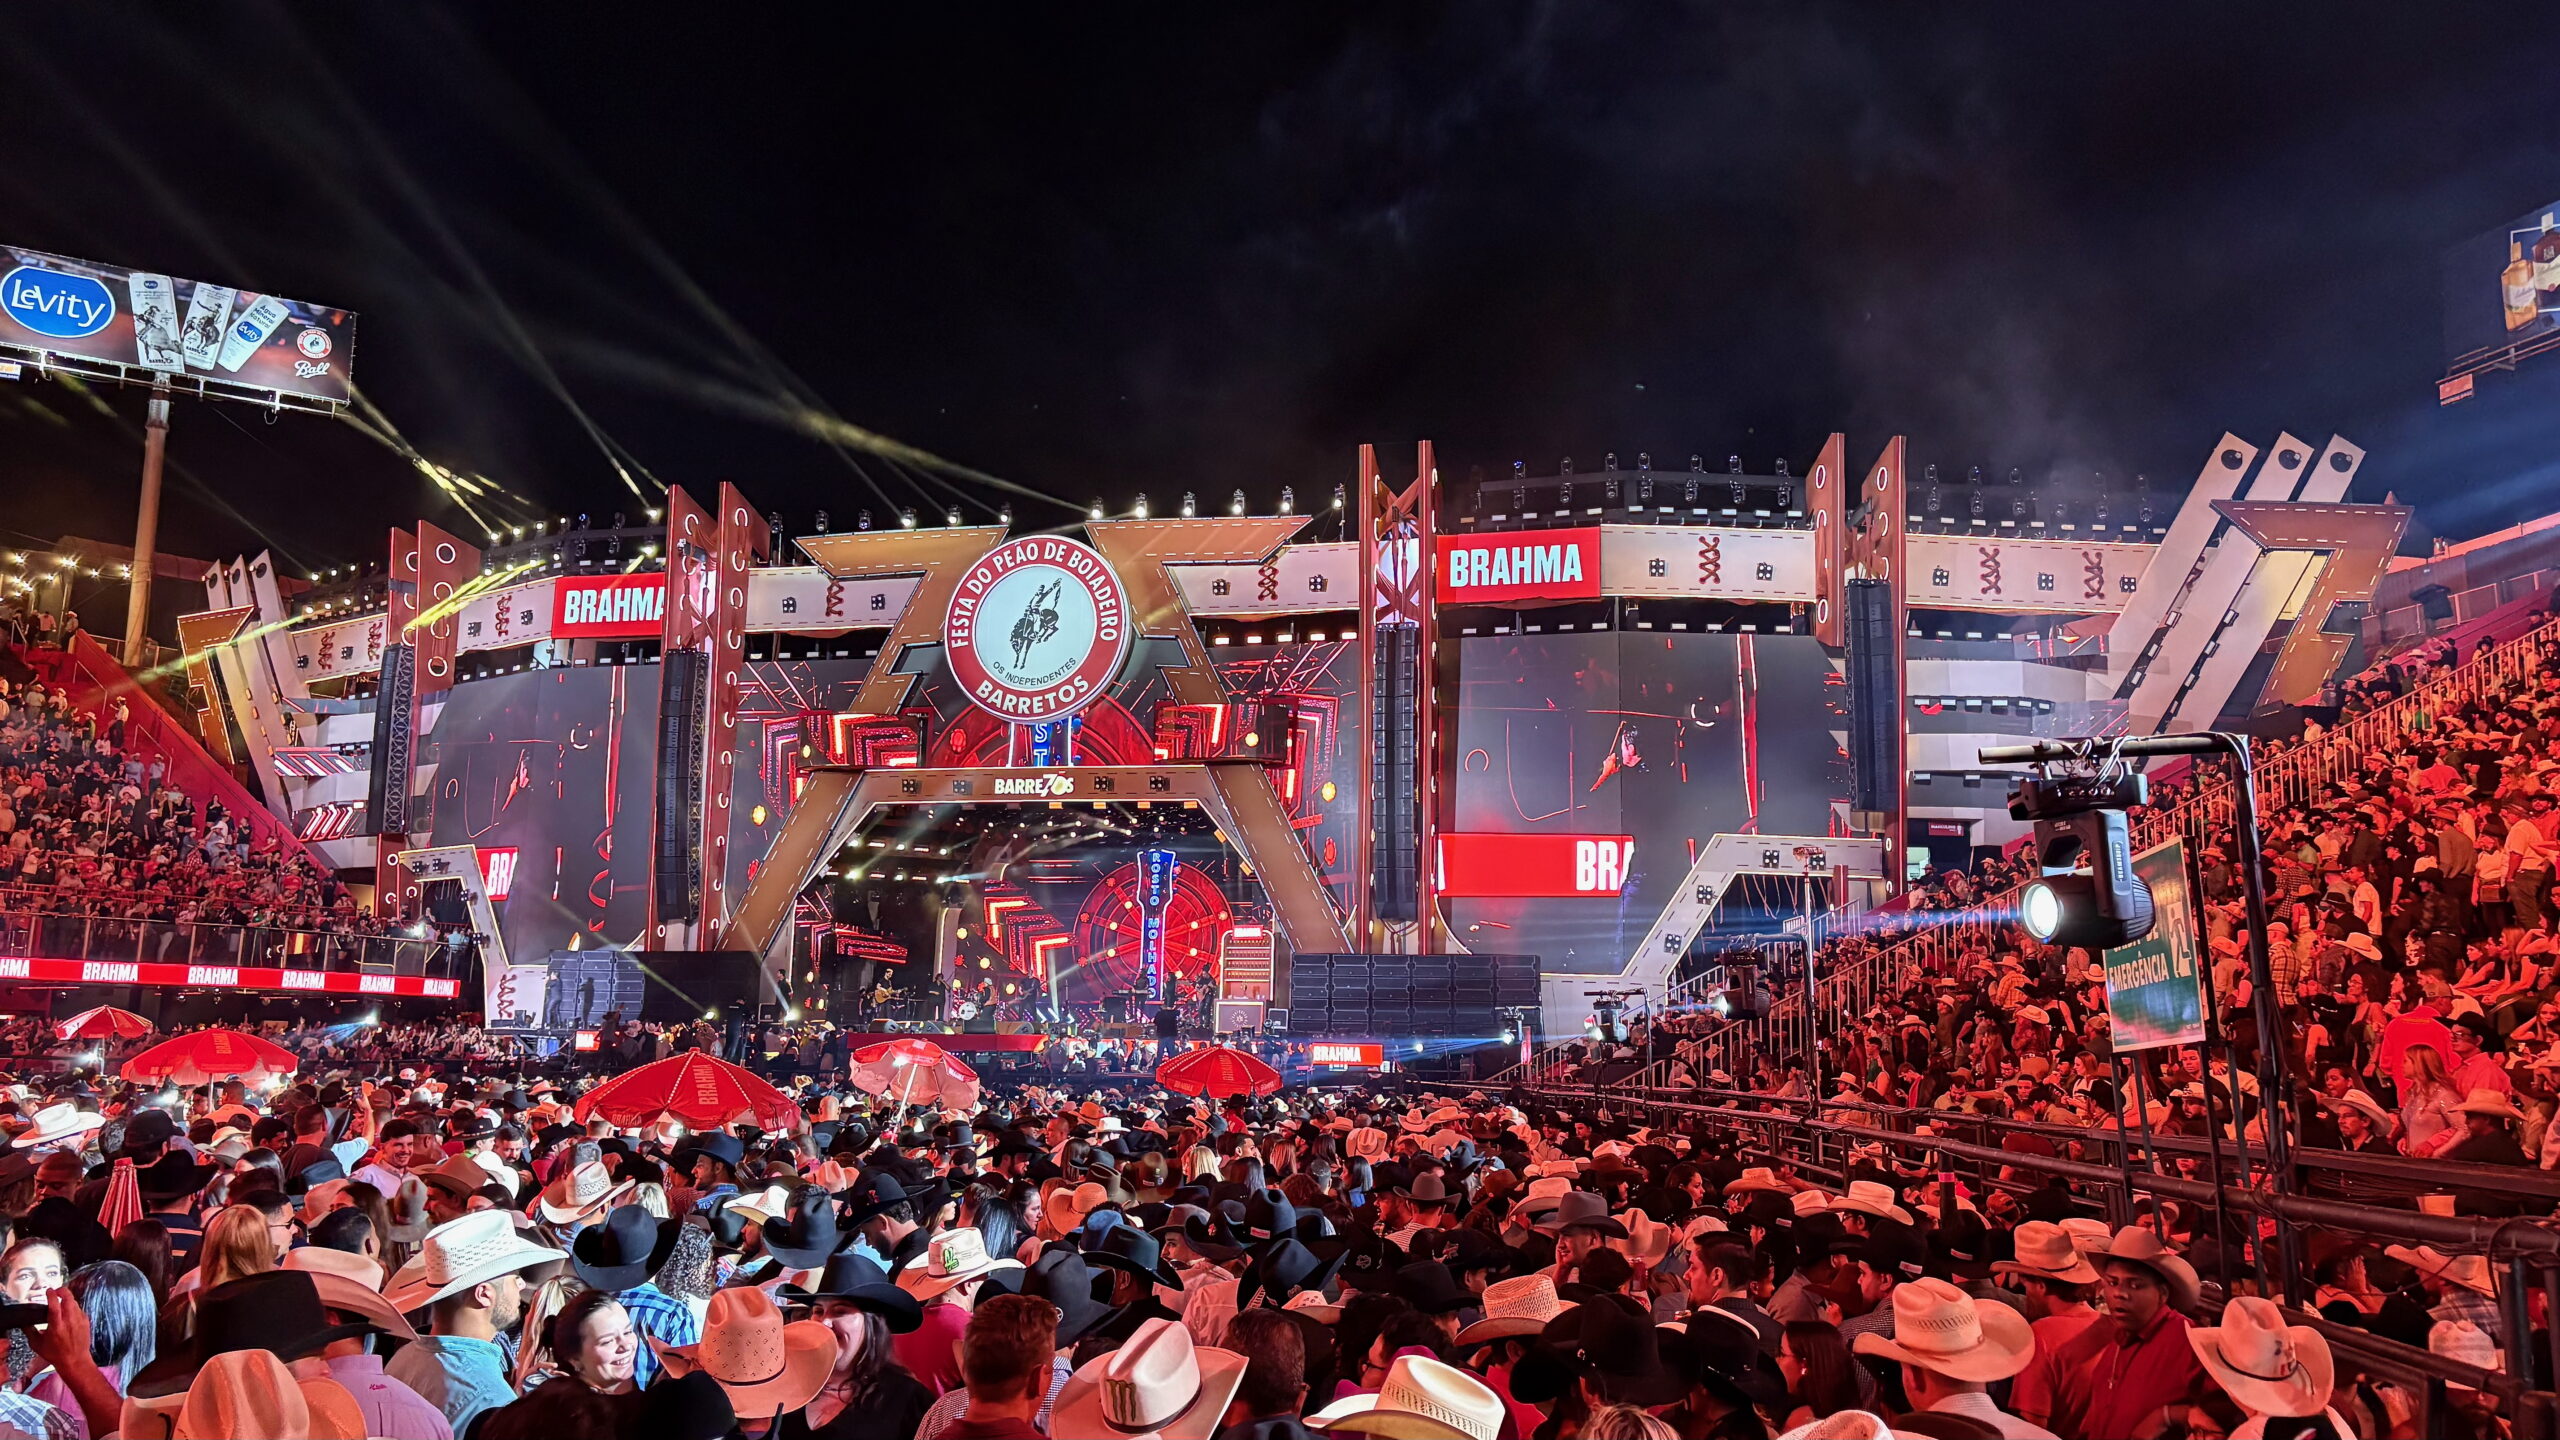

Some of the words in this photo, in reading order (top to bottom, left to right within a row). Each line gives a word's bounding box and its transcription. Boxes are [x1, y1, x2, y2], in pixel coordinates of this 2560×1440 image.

[294, 360, 331, 379] Ball
[1450, 543, 1583, 588] BRAHMA
[952, 596, 976, 648] FESTA
[967, 566, 992, 595] DO
[992, 541, 1039, 573] PEÃO
[1043, 541, 1068, 563] DE
[1067, 549, 1119, 641] BOIADEIRO
[993, 660, 1005, 675] OS
[1004, 657, 1077, 686] INDEPENDENTES
[976, 674, 1089, 715] BARRETOS
[1149, 852, 1162, 906] ROSTO
[82, 962, 139, 982] BRAHMA
[187, 966, 239, 985] BRAHMA
[281, 970, 326, 990] BRAHMA
[359, 974, 396, 993] BRAHMA
[422, 979, 455, 996] BRAHMA
[1147, 917, 1160, 999] MOLHADO
[2108, 950, 2170, 993] EMERGÊNCIA
[1313, 1045, 1362, 1063] BRAHMA
[692, 1064, 719, 1106] BRAHMA
